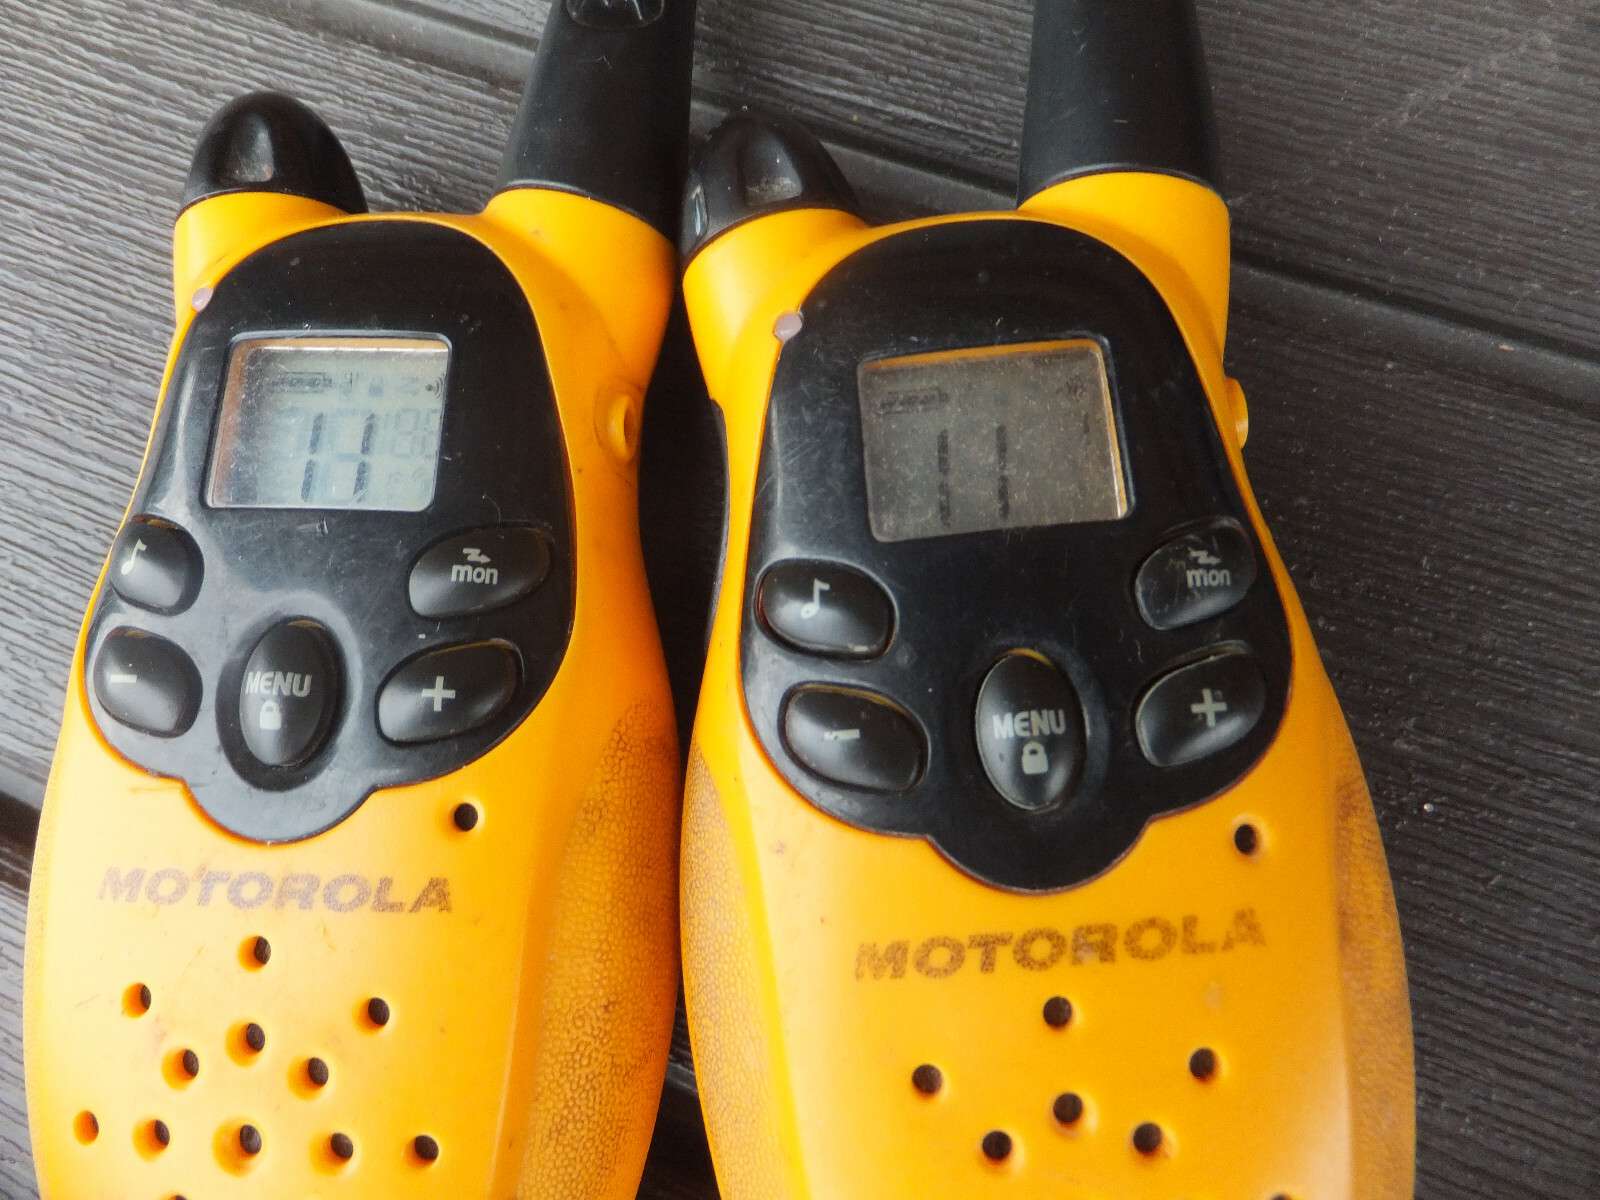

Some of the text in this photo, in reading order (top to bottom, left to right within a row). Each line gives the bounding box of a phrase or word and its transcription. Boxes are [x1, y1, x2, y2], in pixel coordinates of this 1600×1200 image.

[450, 561, 499, 586] mon
[1186, 566, 1231, 590] mon
[245, 670, 312, 698] MENU
[992, 708, 1067, 741] MENU
[98, 866, 453, 915] MOTOROLA
[854, 907, 1268, 983] MOTOROLA
